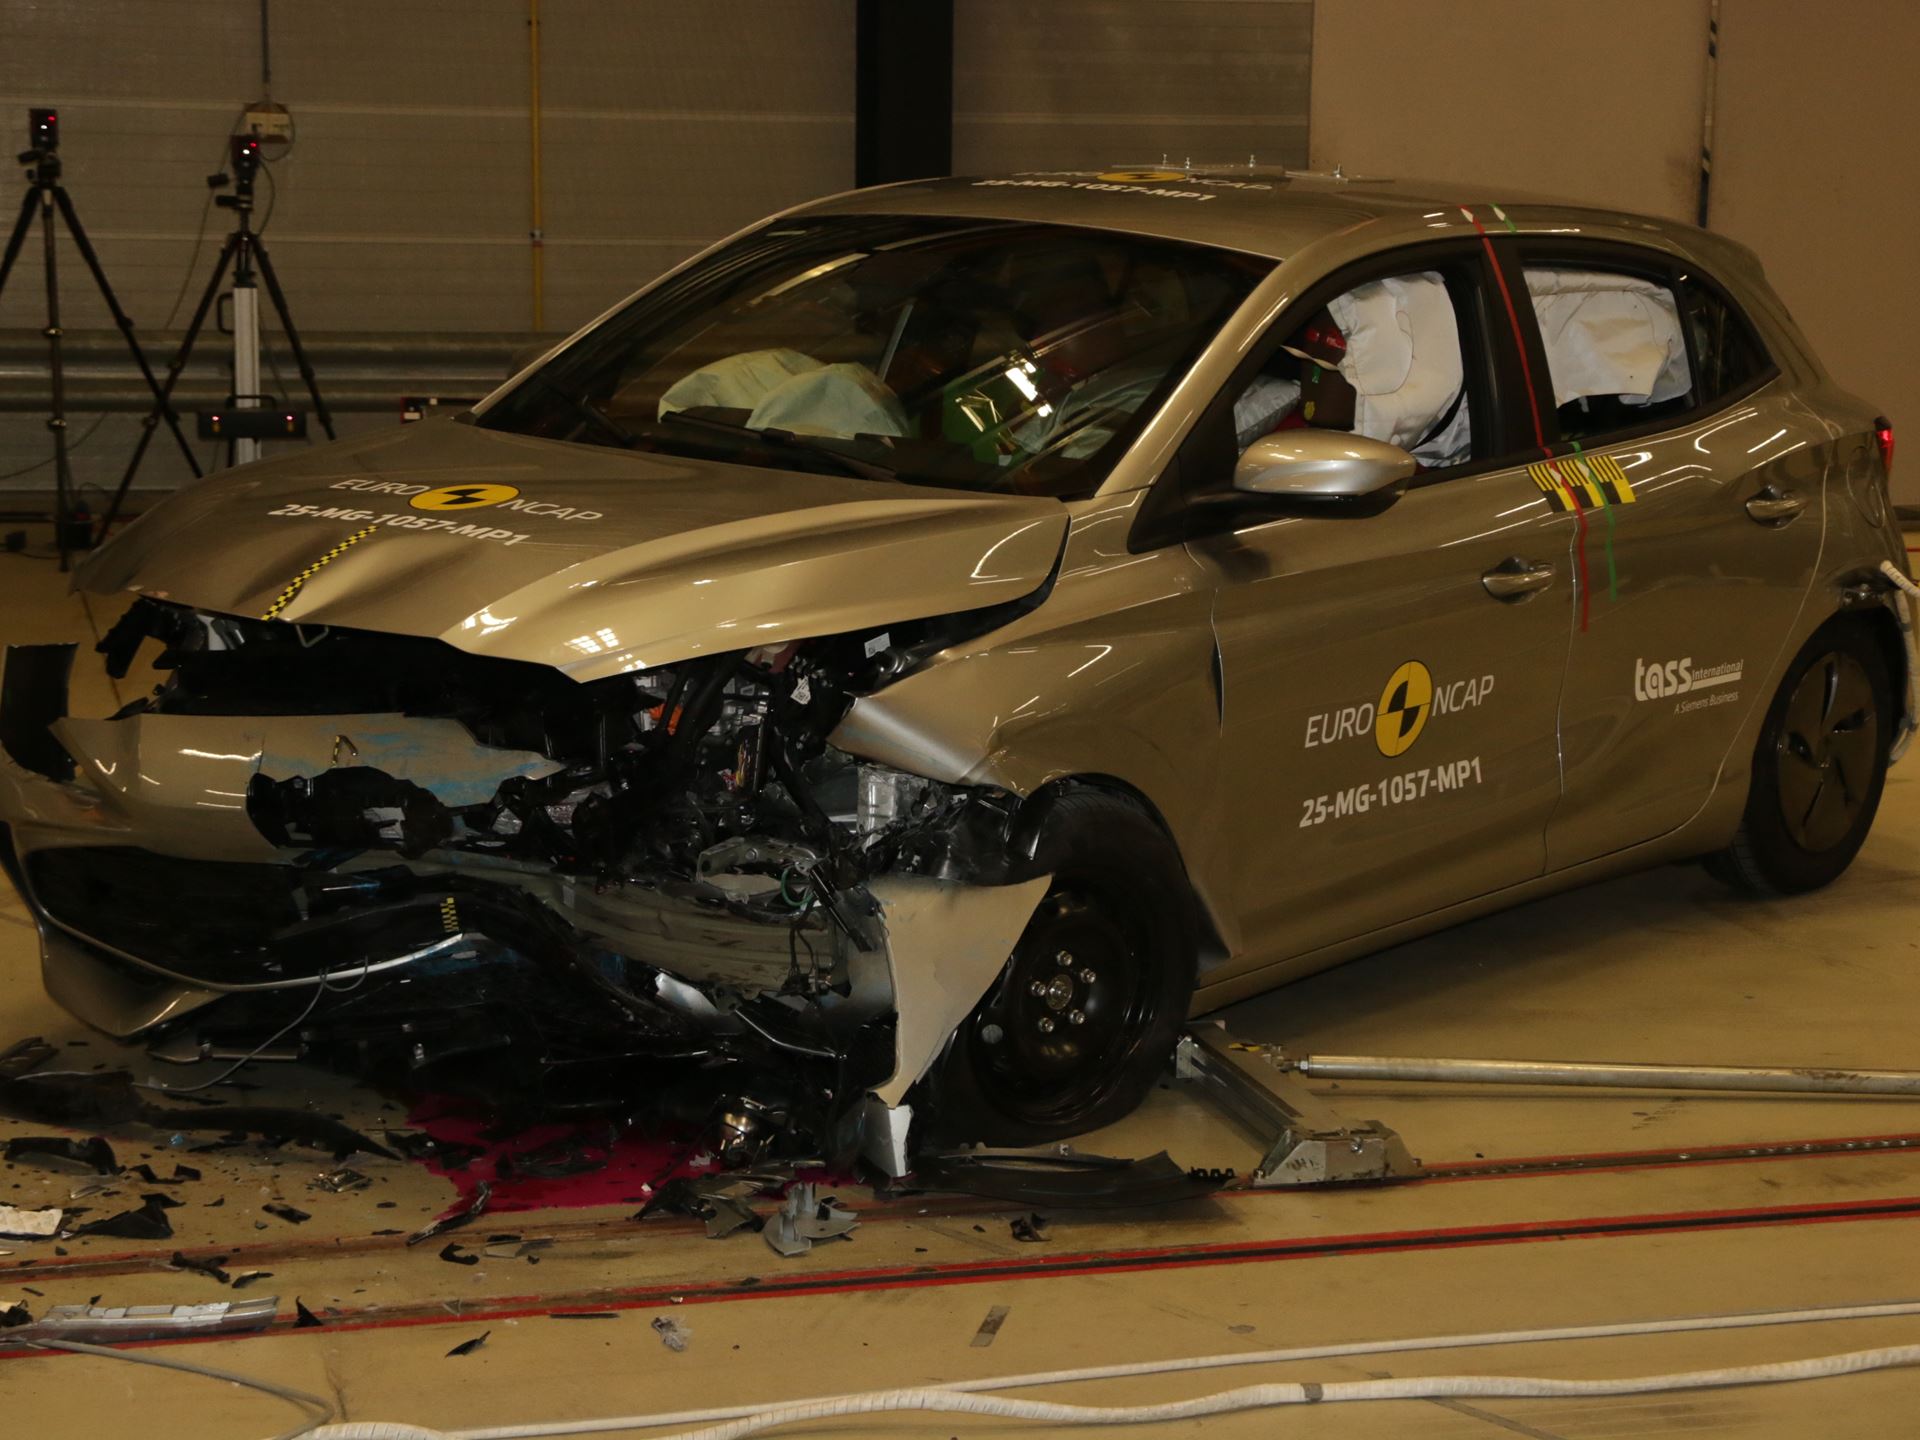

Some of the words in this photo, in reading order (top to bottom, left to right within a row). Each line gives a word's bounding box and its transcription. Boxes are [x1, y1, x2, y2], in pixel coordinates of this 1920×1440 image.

[329, 478, 431, 496] EURO
[497, 498, 604, 522] NCAP
[267, 504, 531, 547] 25-MG-1057-MP1
[1634, 656, 1692, 702] tass
[1304, 702, 1375, 749] EURO
[1431, 674, 1495, 717] NCAP
[1673, 703, 1681, 716] A
[1680, 697, 1709, 714] Siemens
[1709, 691, 1739, 707] Business
[1299, 756, 1483, 829] 25-MG-1057-MP1
